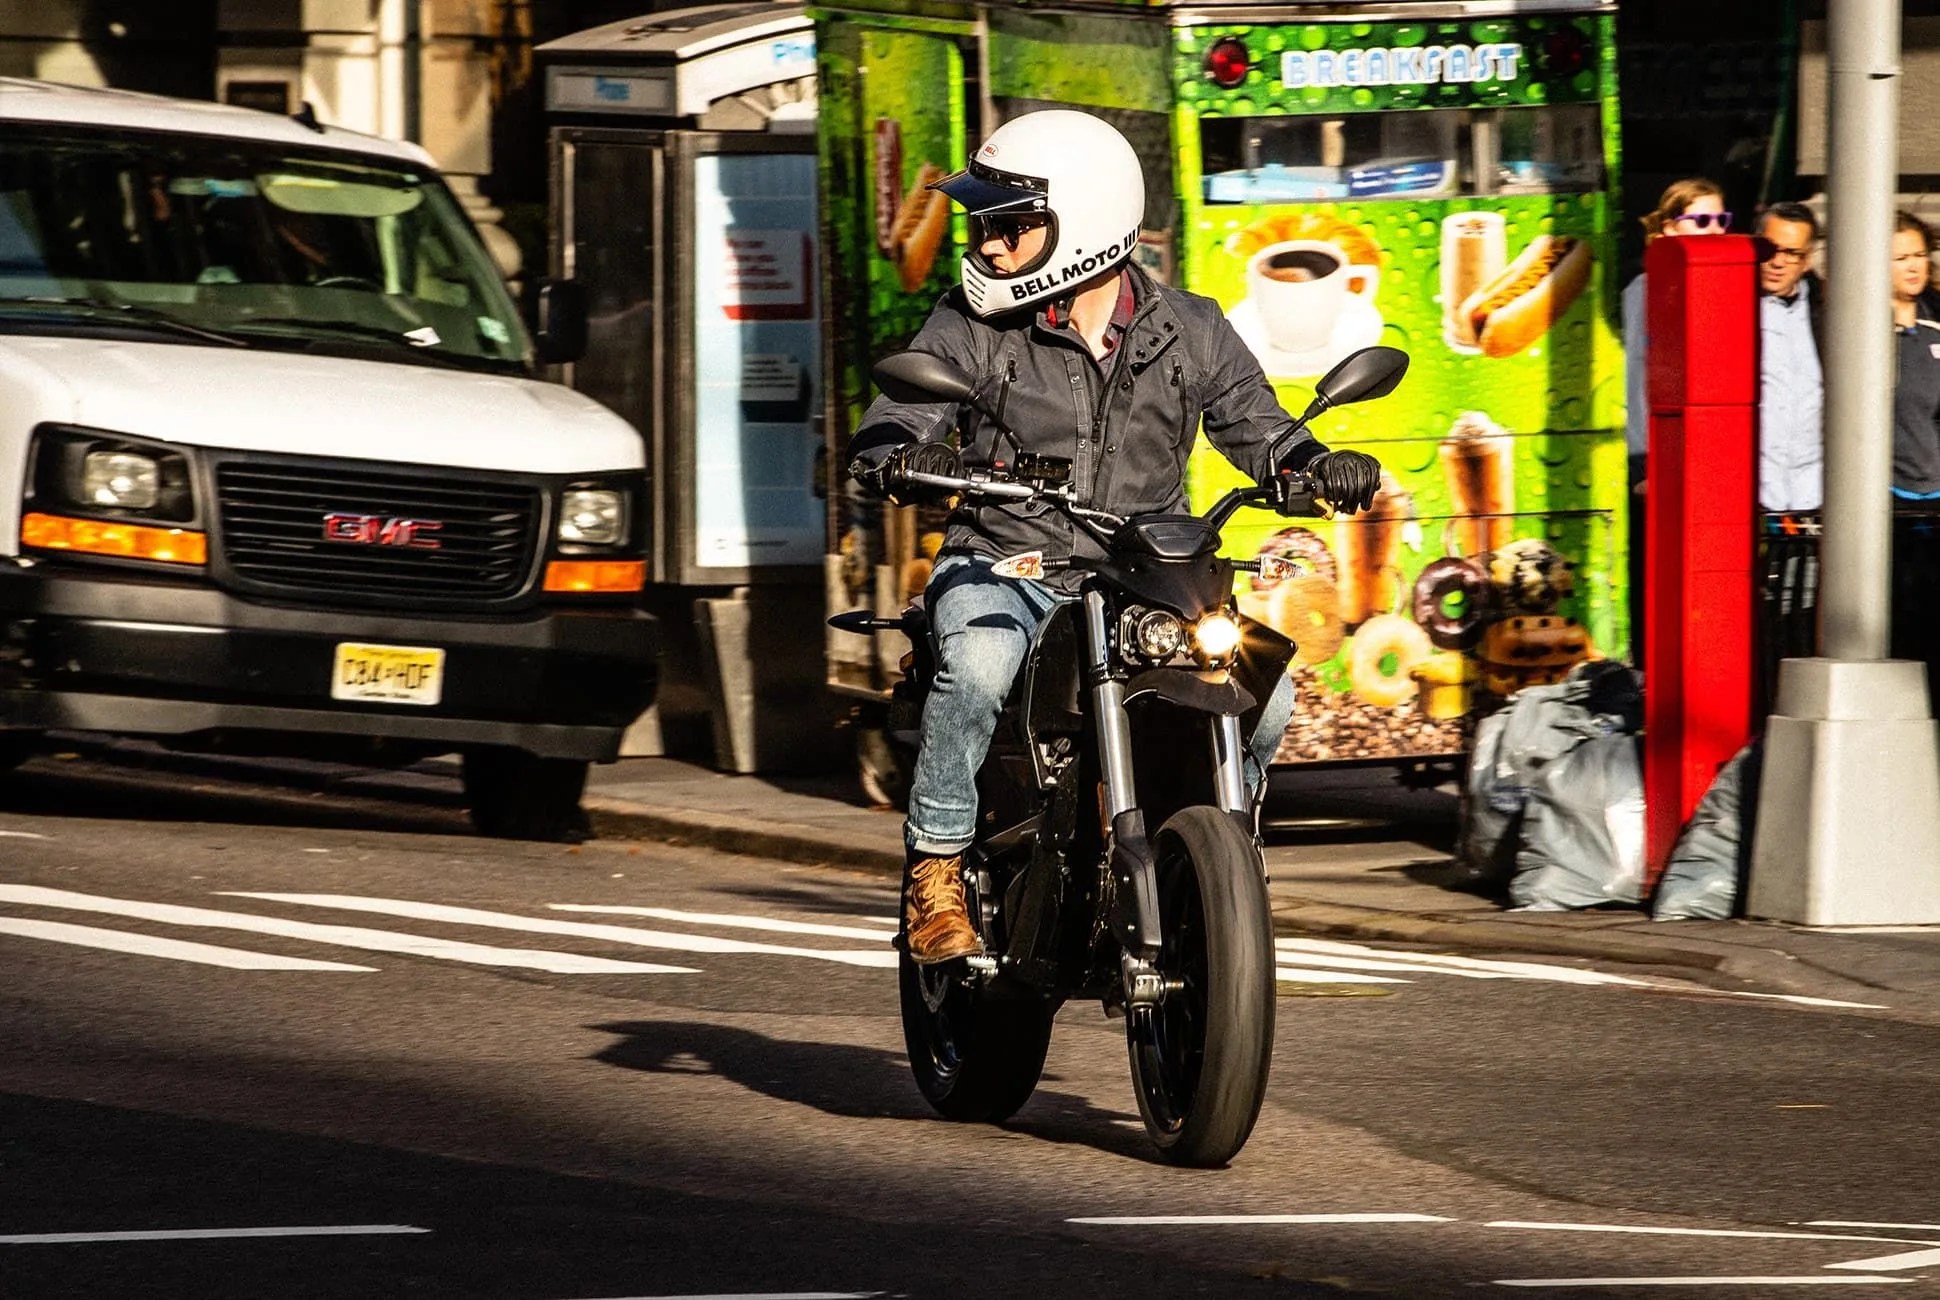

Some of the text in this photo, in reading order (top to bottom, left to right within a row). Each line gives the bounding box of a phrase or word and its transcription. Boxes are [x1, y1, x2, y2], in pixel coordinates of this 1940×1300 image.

[1281, 43, 1522, 88] BREAKFAST
[985, 145, 997, 155] BELL
[1010, 273, 1060, 301] BELL
[1061, 244, 1121, 282] MOTO
[323, 512, 443, 548] GMC
